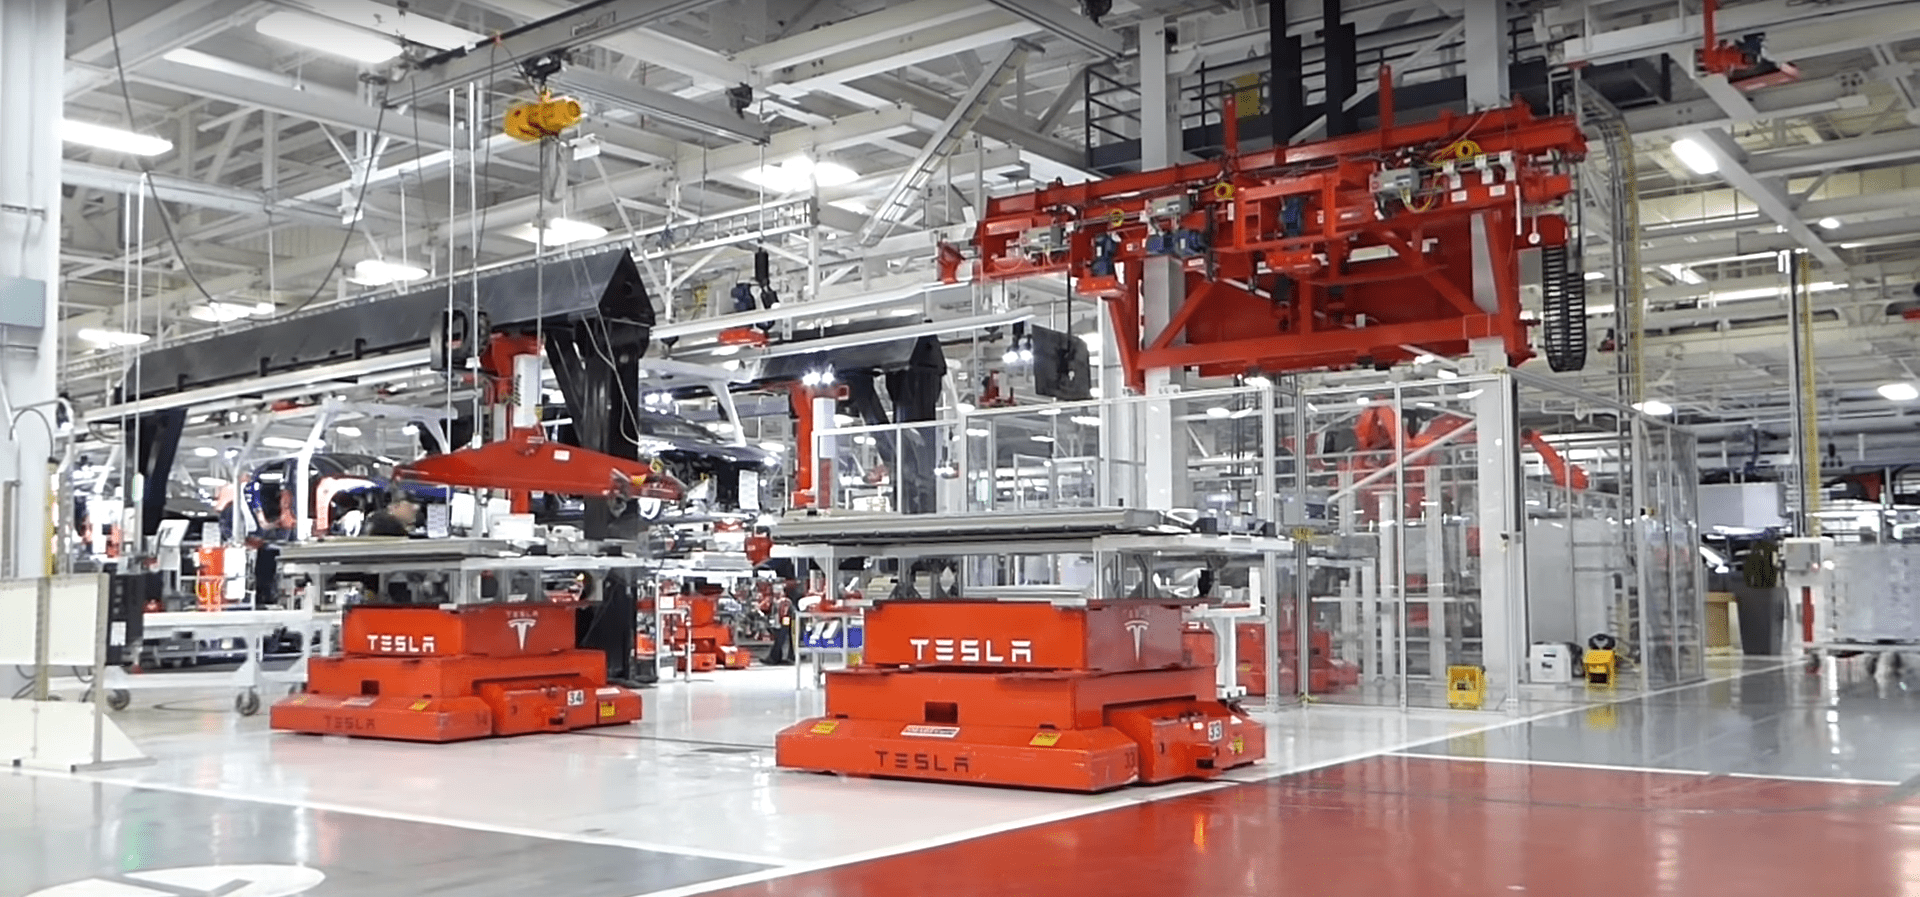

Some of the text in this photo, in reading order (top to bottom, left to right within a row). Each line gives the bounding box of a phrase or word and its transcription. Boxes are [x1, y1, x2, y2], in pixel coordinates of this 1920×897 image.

[367, 634, 434, 653] TESLA
[909, 638, 1031, 662] TESLA
[569, 692, 582, 704] 34
[323, 715, 376, 730] TESLA
[875, 750, 969, 773] TESLA
